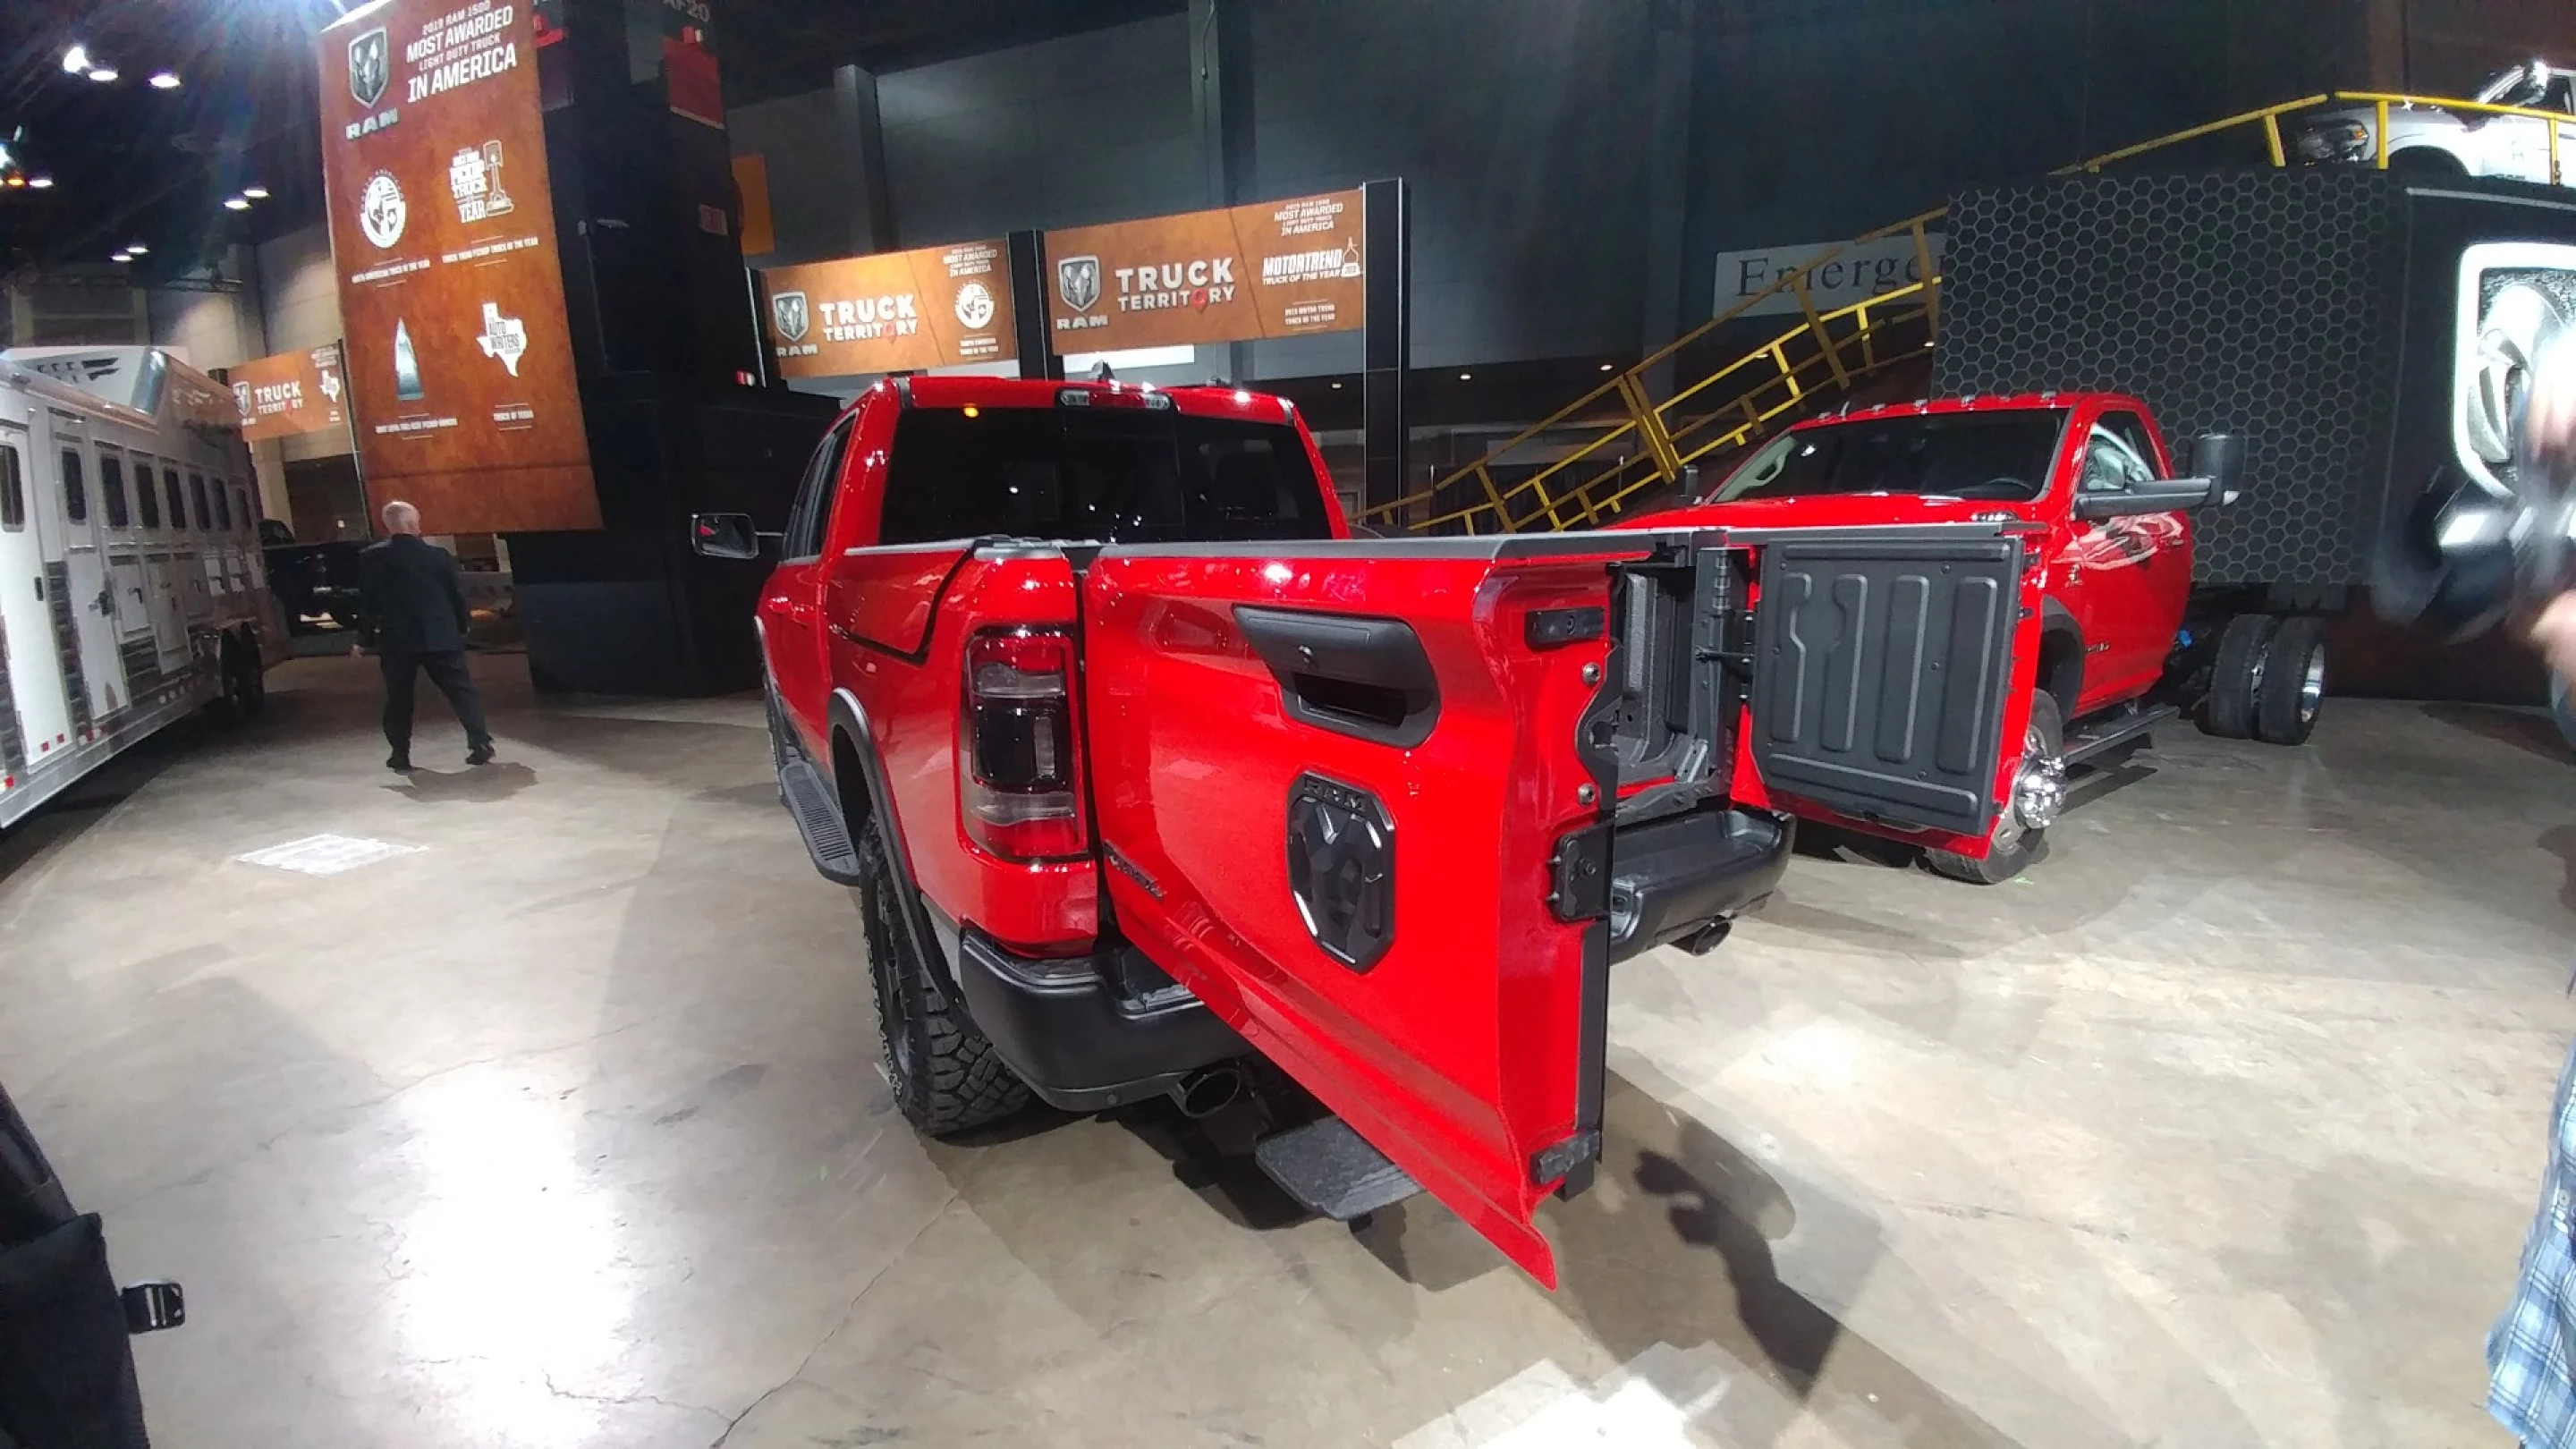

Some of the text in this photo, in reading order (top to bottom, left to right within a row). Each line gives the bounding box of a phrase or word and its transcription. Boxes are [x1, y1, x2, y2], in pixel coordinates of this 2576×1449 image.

[445, 9, 465, 26] RAM
[406, 4, 513, 63] MOST AWARDED
[419, 32, 501, 72] LIGHT DUTY TRUCK
[407, 42, 517, 103] IN AMERICA
[345, 107, 399, 140] RAM
[458, 199, 487, 223] YEAR
[1274, 203, 1344, 223] MOST AWARDED
[1281, 221, 1335, 237] IN AMERICA
[943, 253, 963, 265] MOST
[959, 264, 993, 275] AMERICA
[1263, 249, 1343, 276] MOTORTREND
[1115, 257, 1234, 293] TRUCK
[1262, 275, 1288, 285] TRUCK
[1289, 273, 1301, 283] OF
[1302, 271, 1318, 282] THE
[1319, 268, 1341, 279] YEAR
[819, 293, 918, 326] TRUCK
[1118, 285, 1235, 314] TERRITORY
[488, 321, 506, 335] AUTO
[823, 318, 919, 343] TERRITORY
[1056, 314, 1109, 330] RAM
[490, 332, 521, 350] WRITERS
[776, 343, 819, 357] RAM
[255, 380, 301, 403] TRUCK
[1304, 776, 1366, 812] RAM
